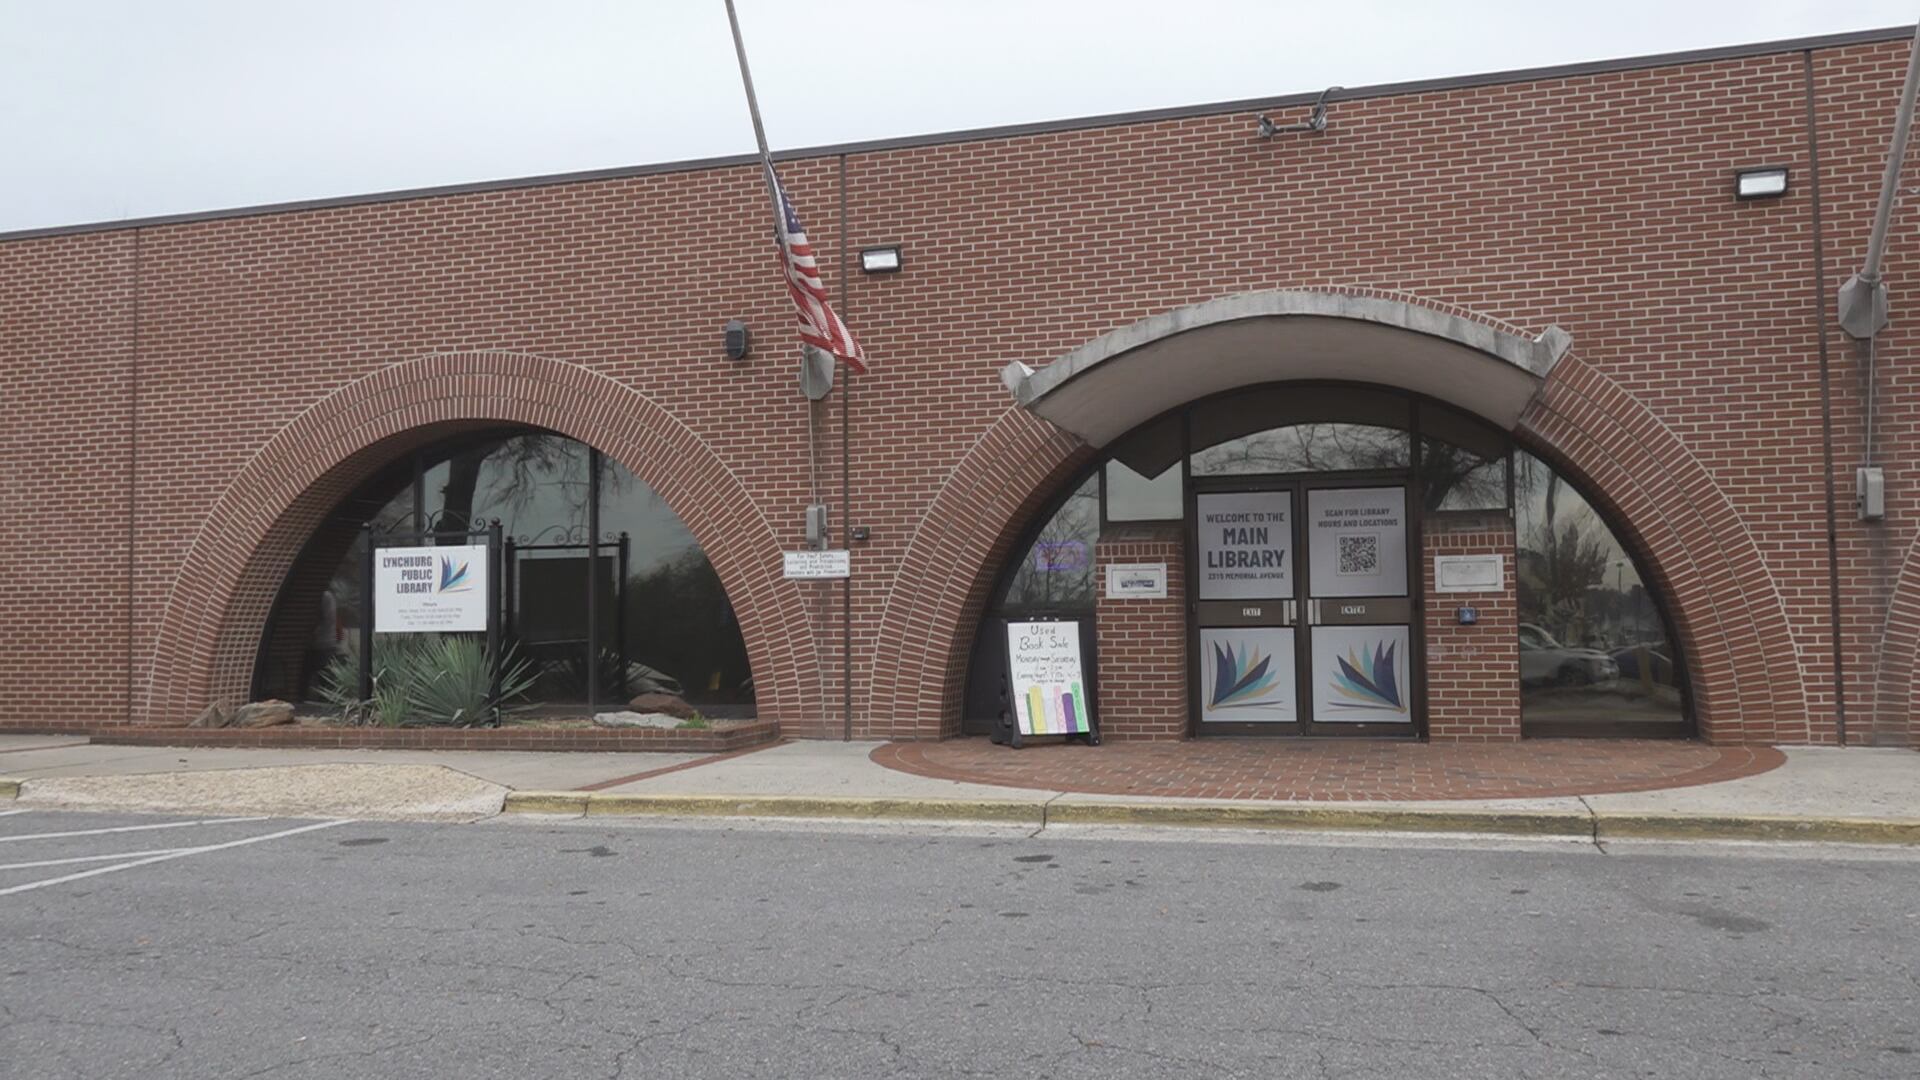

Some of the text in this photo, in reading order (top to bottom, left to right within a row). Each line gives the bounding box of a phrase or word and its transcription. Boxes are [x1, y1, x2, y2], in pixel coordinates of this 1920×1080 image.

[1206, 512, 1285, 523] WELCOME TO THE
[1325, 508, 1391, 517] SCAN FOR LIBRARY
[1318, 518, 1398, 528] HOURS AND LOCATIONS
[1223, 527, 1269, 546] MAIN
[383, 556, 433, 568] LYNCHBURG
[1207, 549, 1285, 568] LIBRARY
[402, 569, 433, 580] PUBLIC
[1225, 572, 1258, 580] MEMORIAL
[396, 582, 433, 594] LIBRARY
[1030, 625, 1056, 635] Used
[1019, 636, 1043, 651] Book
